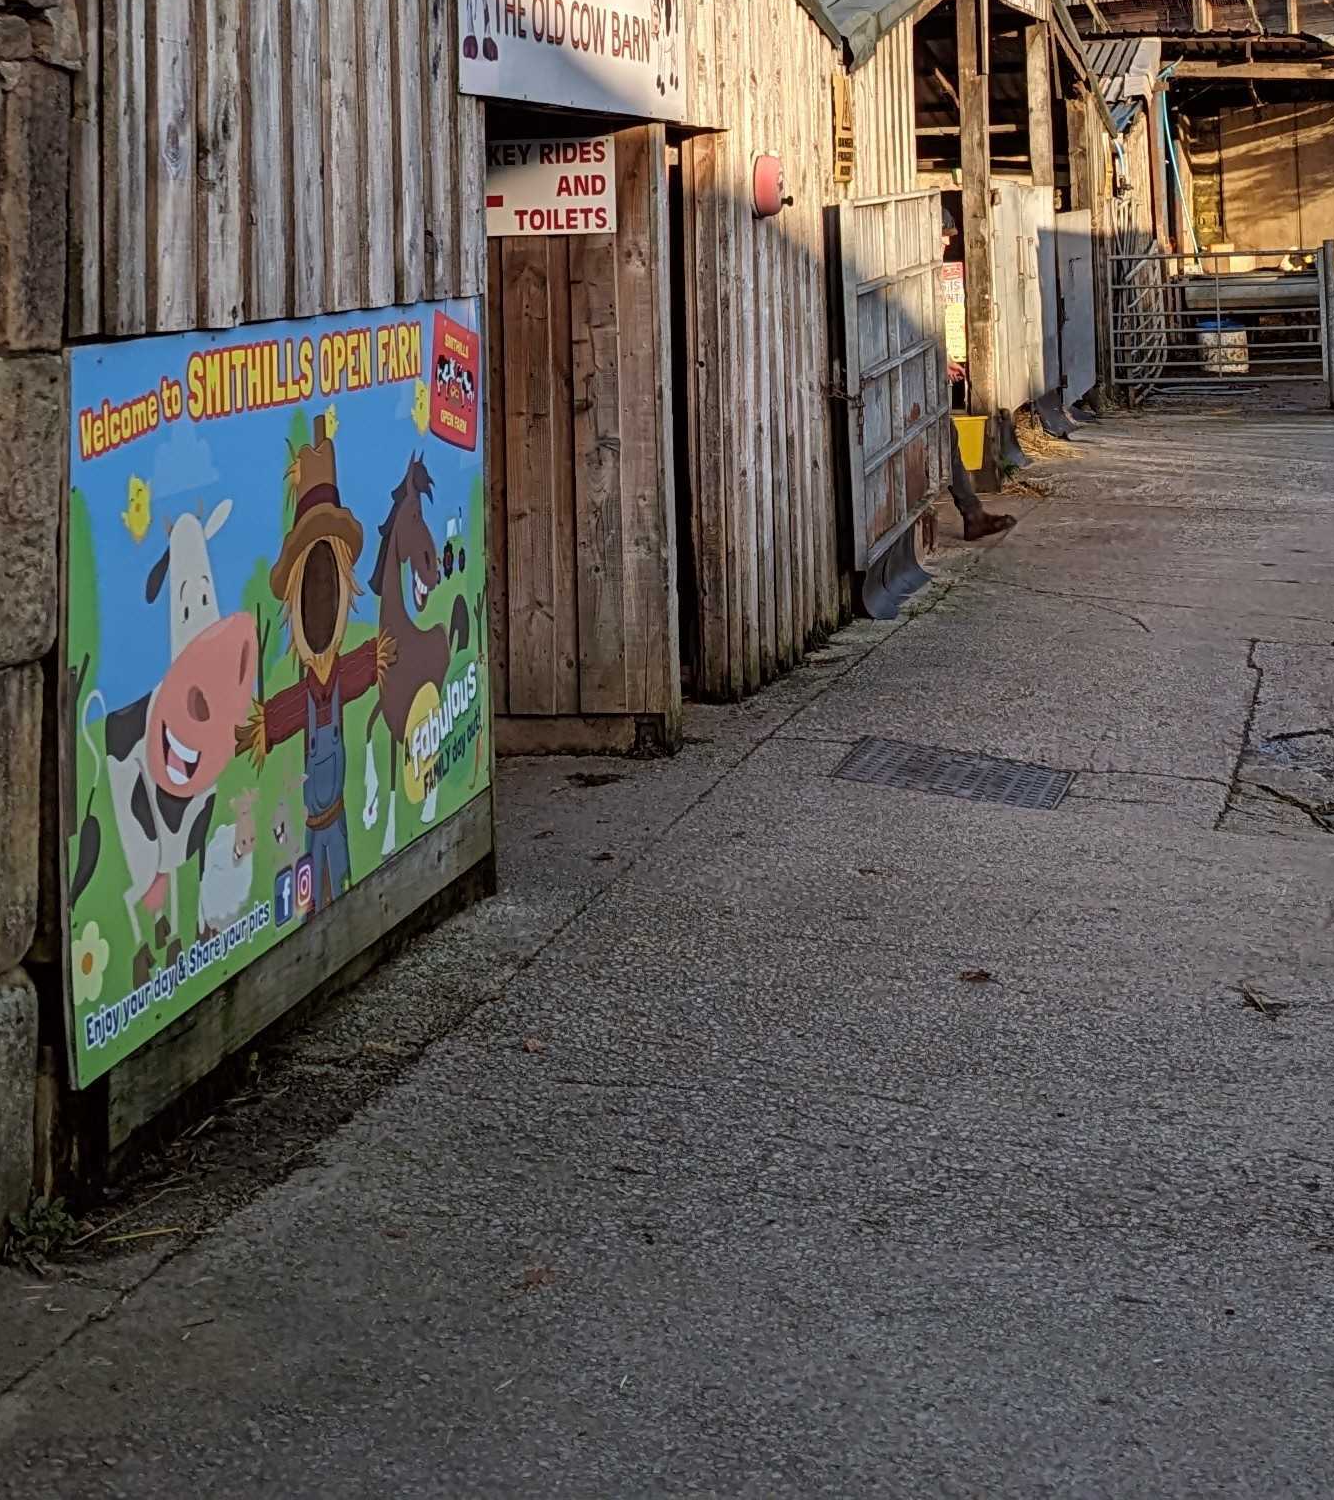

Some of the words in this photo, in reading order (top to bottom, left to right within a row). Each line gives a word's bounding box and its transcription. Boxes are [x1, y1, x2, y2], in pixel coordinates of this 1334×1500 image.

[569, 0, 607, 53] COW
[611, 12, 651, 64] BARN
[539, 140, 606, 165] RIDES
[556, 174, 607, 197] AND
[514, 207, 607, 231] TOILETS
[79, 392, 159, 461] Welcome
[161, 378, 182, 419] to
[187, 336, 314, 422] SMITHILLS
[318, 327, 372, 395] OPEN
[377, 320, 422, 384] FARM
[404, 736, 410, 766] A
[411, 662, 477, 781] fabulous
[424, 744, 451, 799] FAMILY
[452, 731, 466, 763] day
[85, 1003, 120, 1048] Enjoy
[122, 983, 152, 1031] your
[154, 967, 176, 999] day
[177, 952, 187, 985] &
[222, 919, 248, 959] your
[248, 901, 271, 942] pics
